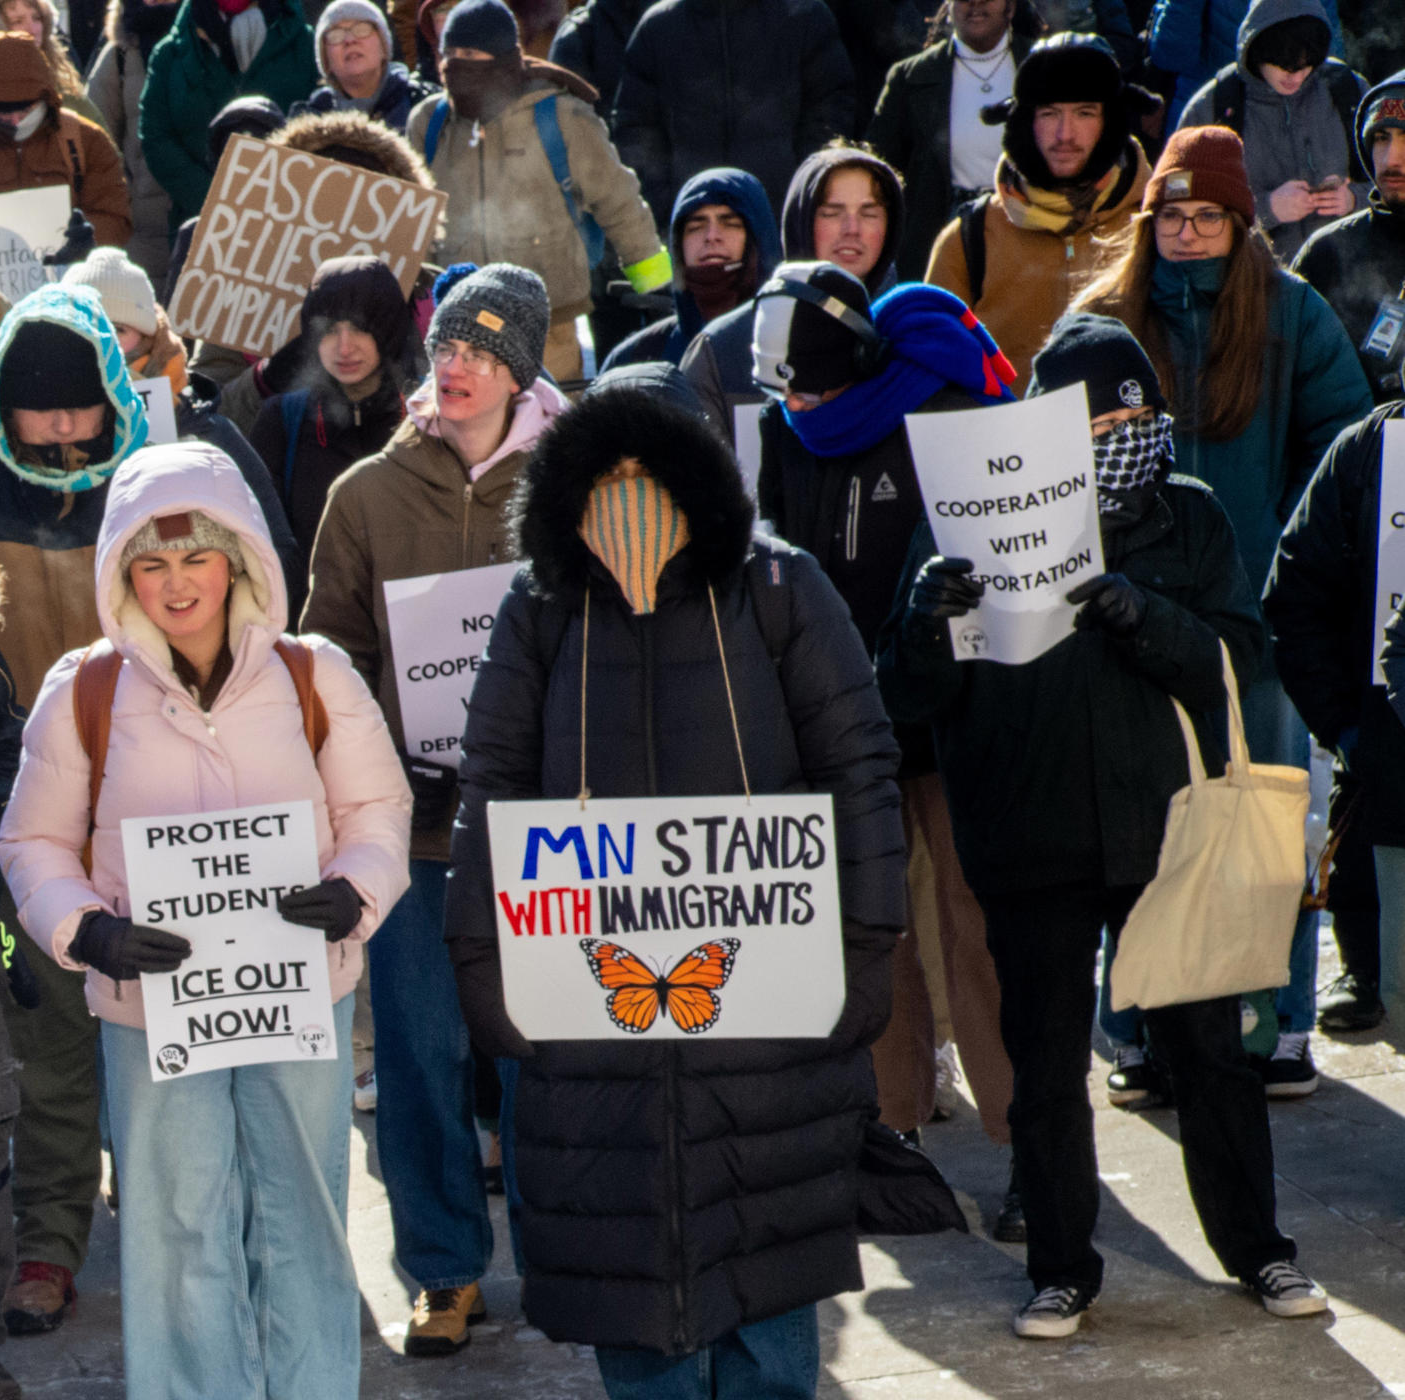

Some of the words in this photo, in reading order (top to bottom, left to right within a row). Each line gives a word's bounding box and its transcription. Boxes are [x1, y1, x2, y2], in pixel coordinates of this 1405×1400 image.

[219, 139, 437, 252] FASCISM
[193, 203, 341, 298] RELIES
[987, 454, 1024, 476] NO
[935, 472, 1087, 518] COOPERATION
[989, 529, 1048, 555] WITH
[967, 548, 1093, 593] EPORTATION
[461, 613, 495, 634] NO
[146, 813, 290, 849] PROTECT
[521, 822, 636, 881] MN
[656, 813, 826, 878] STANDS
[191, 853, 251, 879] THE
[147, 884, 306, 924] STUDENT
[497, 887, 592, 937] WITH
[598, 881, 816, 936] IMMIGRANTS
[171, 967, 225, 1002] ICE
[234, 961, 308, 991] OUT
[187, 1004, 292, 1044] NOW!
